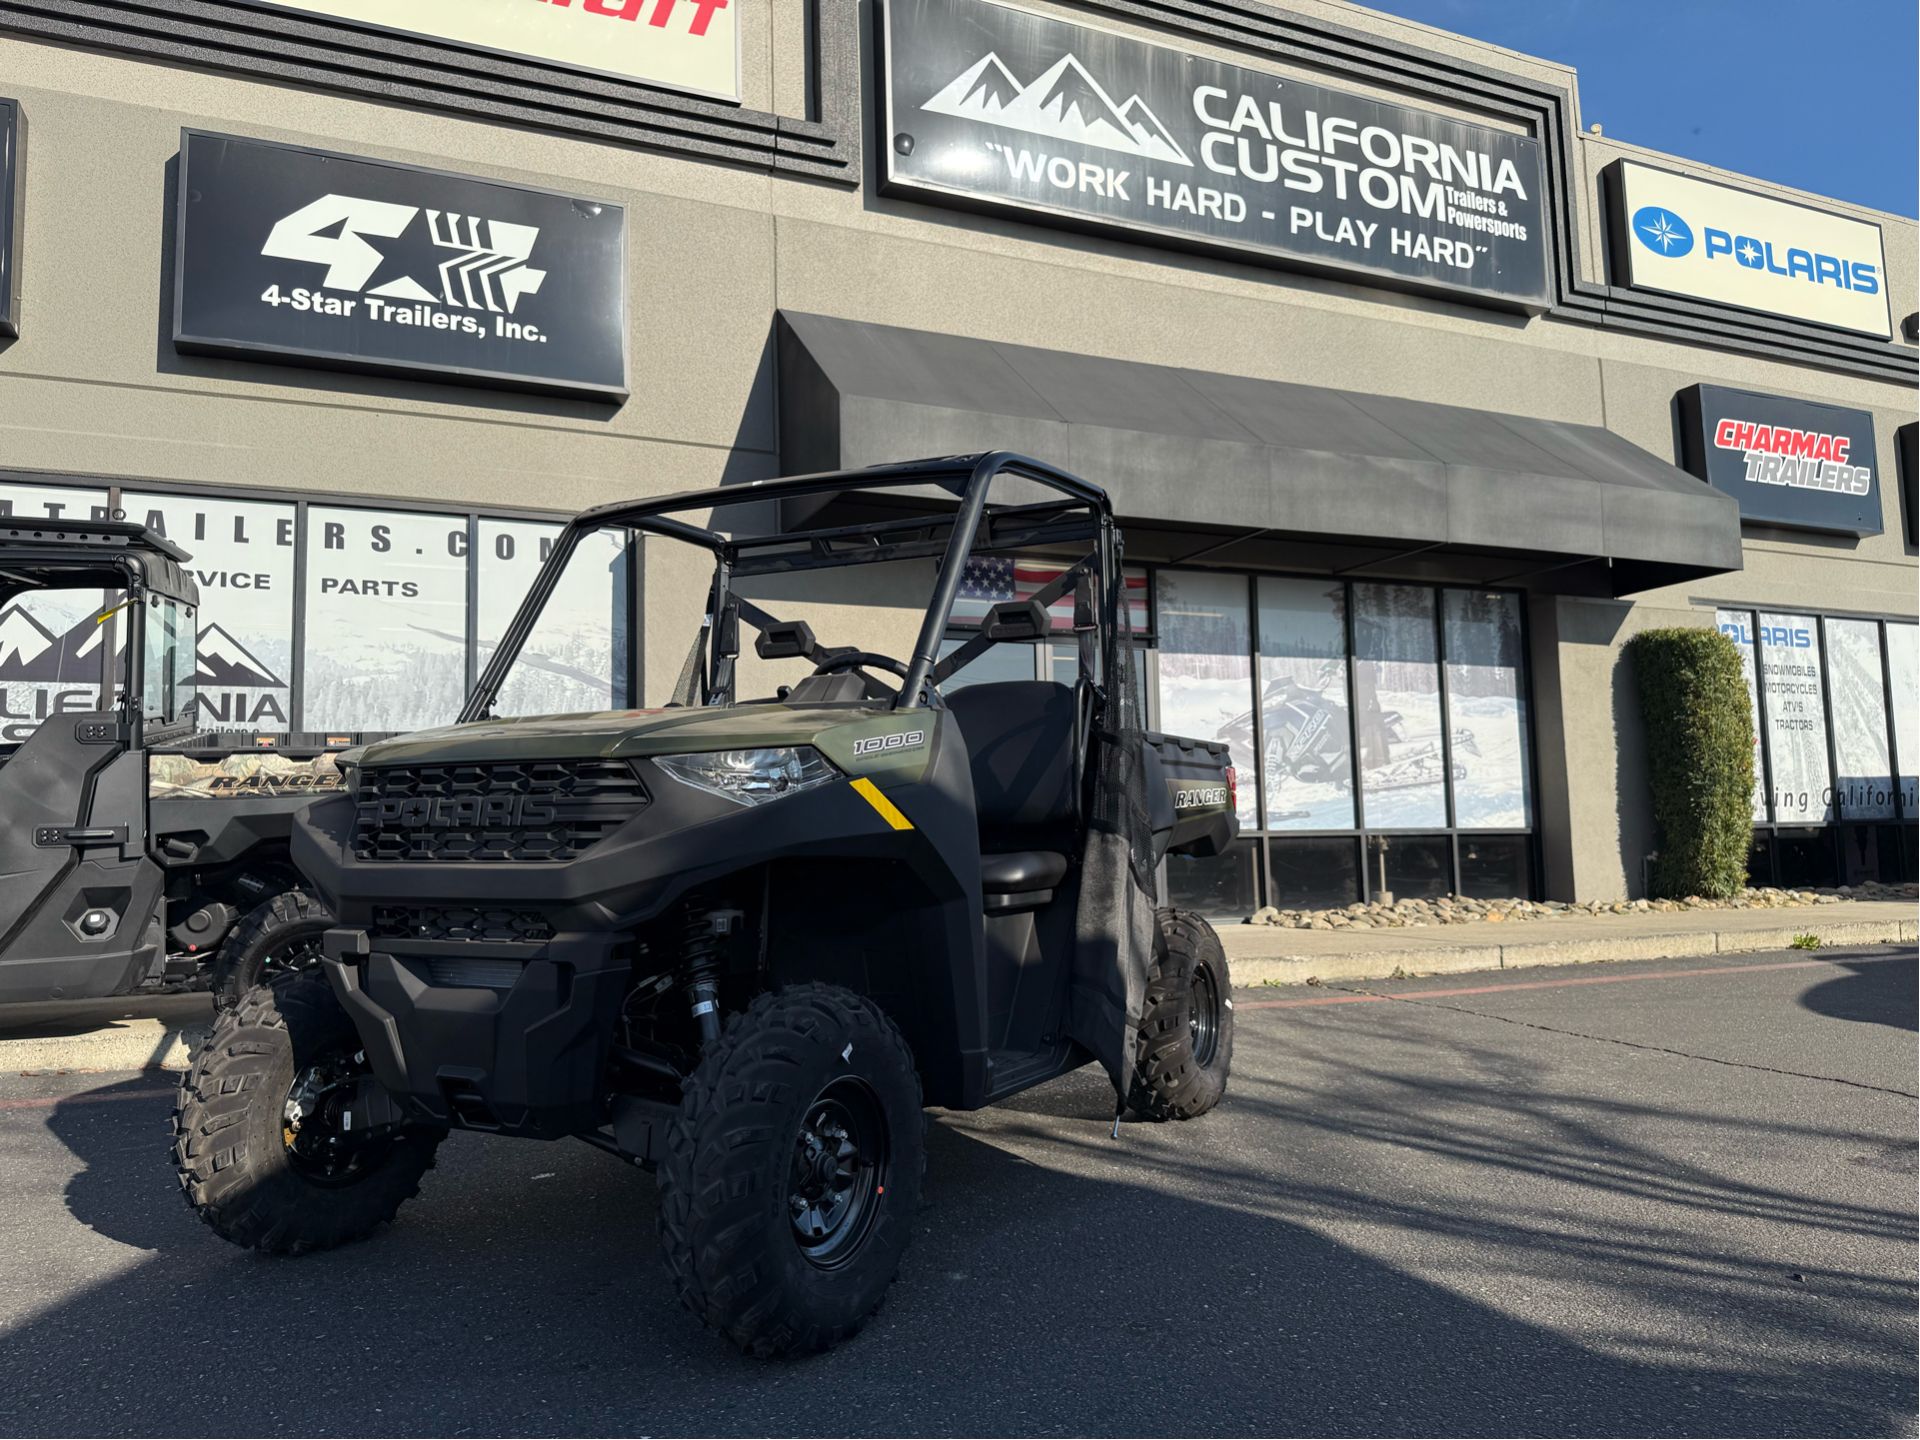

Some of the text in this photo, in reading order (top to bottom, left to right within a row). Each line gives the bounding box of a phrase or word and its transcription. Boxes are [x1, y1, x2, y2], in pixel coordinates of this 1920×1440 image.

[1193, 86, 1528, 201] CALIFORNIA
[1200, 131, 1446, 222] CUSTOM
[1147, 176, 1247, 223] HARD
[1290, 206, 1379, 249] PLAY
[1446, 186, 1508, 217] Trailers &
[1448, 206, 1527, 241] Powersports
[1704, 227, 1879, 295] POLARIS
[261, 285, 547, 343] 4-Star Trailers, Inc.
[1714, 418, 1850, 464] CHARMAC
[1743, 452, 1871, 496] TRAILERS
[186, 570, 271, 590] VICE
[321, 578, 419, 598] PARTS
[1717, 623, 1811, 649] OLARIS
[1763, 664, 1816, 677] SNOWMOBILES
[1765, 682, 1818, 695] MOTORCYCLES
[1783, 701, 1804, 713] ATV'S
[1775, 719, 1814, 731] TRACTORS
[854, 730, 925, 755] 1000
[1175, 788, 1227, 808] RANGER
[1822, 784, 1919, 808] Californi
[377, 795, 556, 828] POLARIS
